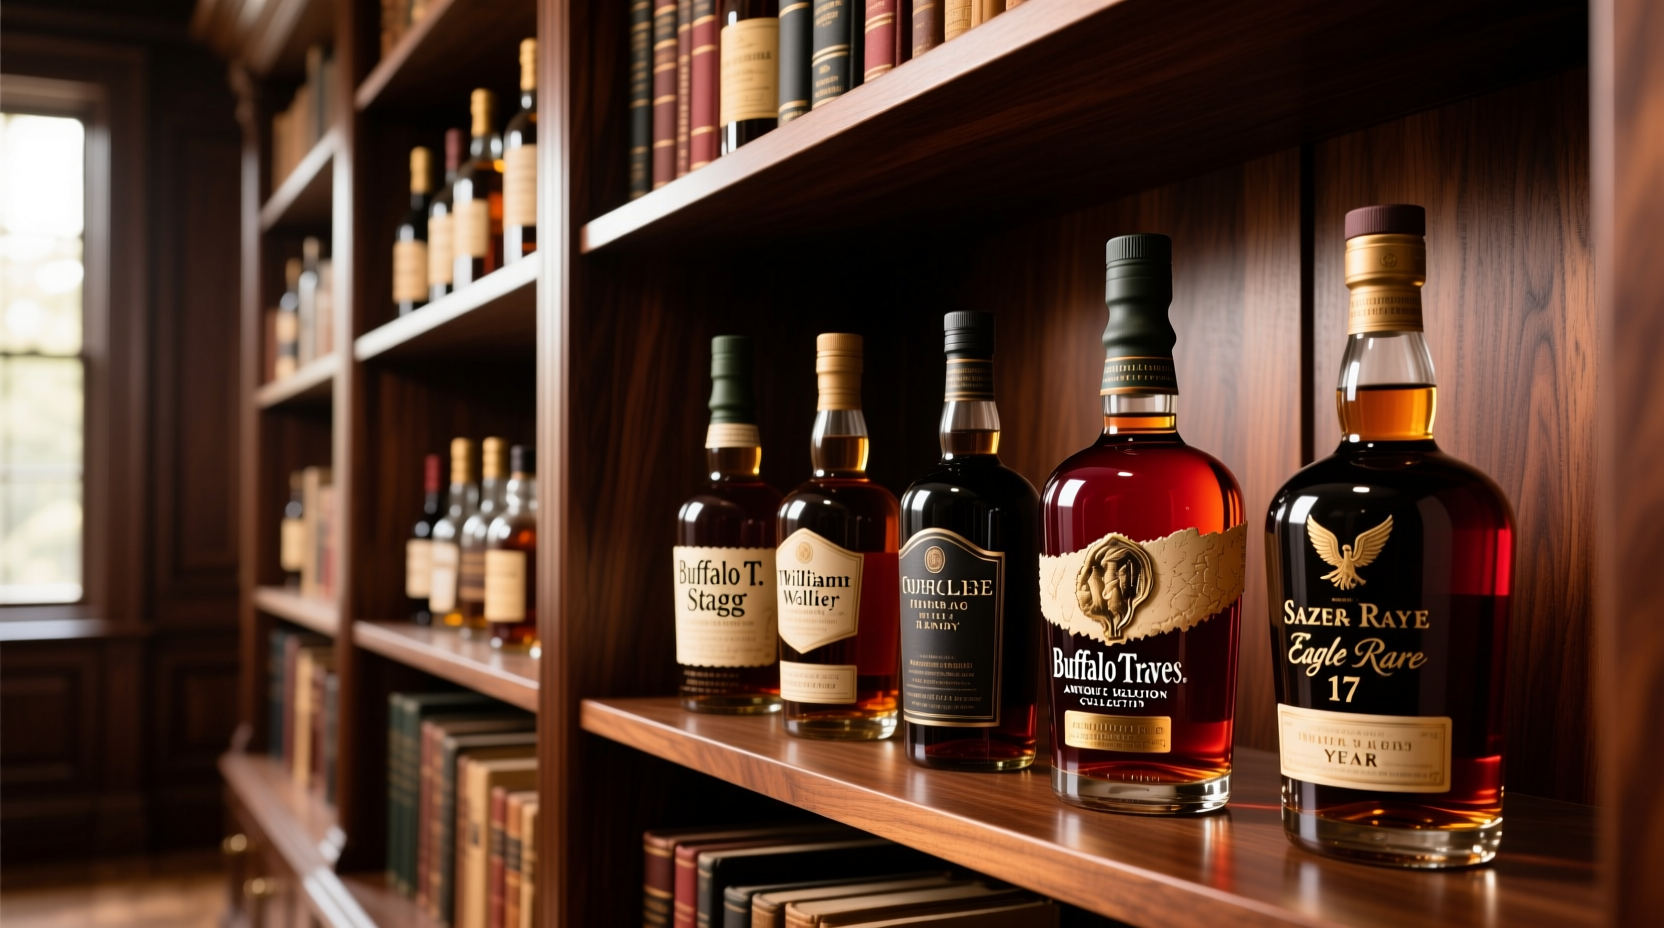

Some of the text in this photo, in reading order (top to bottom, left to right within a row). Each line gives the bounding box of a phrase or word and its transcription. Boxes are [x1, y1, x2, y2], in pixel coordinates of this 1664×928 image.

[679, 560, 763, 586] Buffalo T.
[687, 588, 747, 617] Stagg
[1053, 647, 1116, 682] Buffalo
[1288, 632, 1428, 677] Eagle Rare
[1328, 675, 1361, 703] 17
[1324, 748, 1378, 768] YEAR
